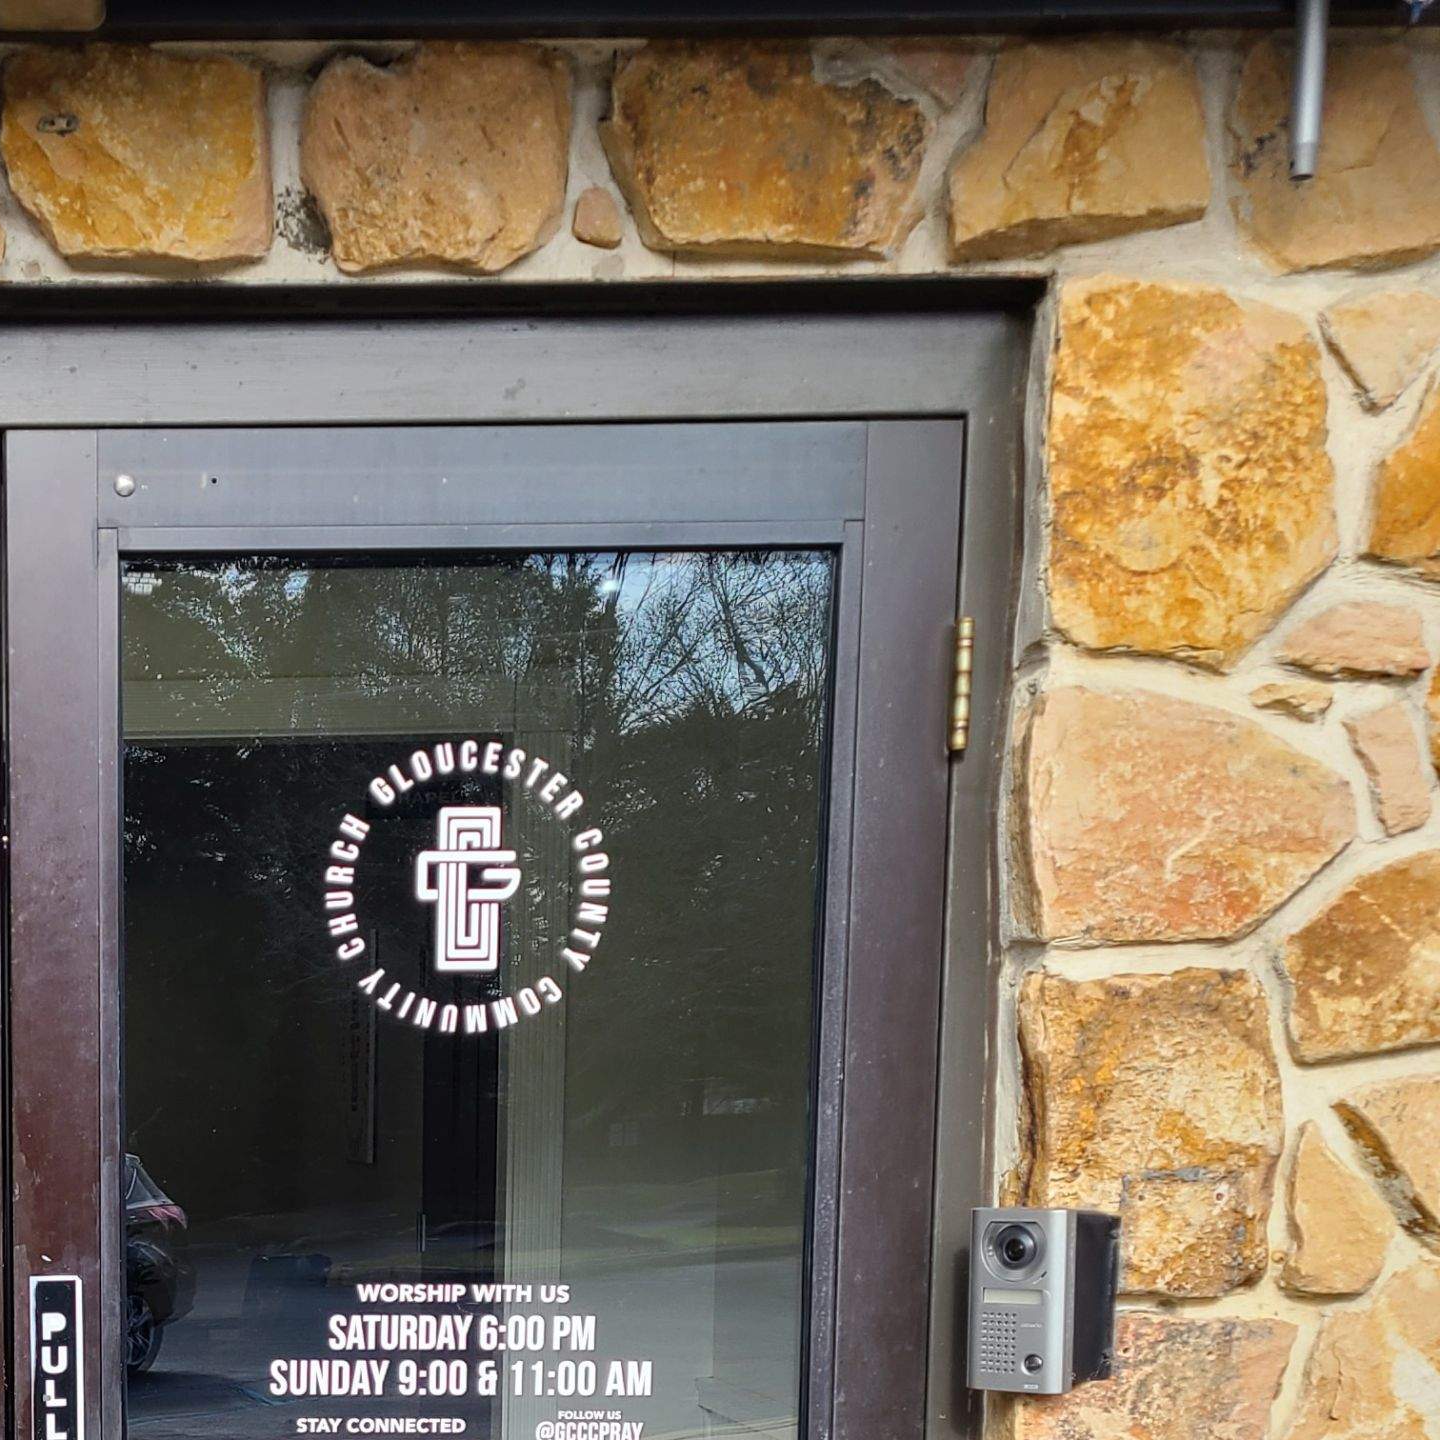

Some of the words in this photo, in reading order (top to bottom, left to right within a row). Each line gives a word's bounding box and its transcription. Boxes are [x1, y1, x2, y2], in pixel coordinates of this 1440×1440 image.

[370, 740, 583, 820] GLOUCESTER
[325, 813, 370, 960] CHURCH
[563, 828, 610, 972] COUNTY
[358, 968, 562, 1034] COMMUNITY
[357, 1283, 466, 1303] WORSHIP
[473, 1284, 532, 1303] WITH
[540, 1284, 570, 1303] US
[328, 1314, 473, 1351] SATURDAY
[479, 1314, 545, 1351] 6:00
[552, 1315, 595, 1351] PM
[41, 1312, 68, 1440] PULL
[269, 1359, 390, 1396] SUNDAY
[398, 1359, 467, 1396] 9:00
[478, 1359, 498, 1396] &
[510, 1360, 596, 1396] 11:00
[605, 1361, 653, 1396] AM
[296, 1418, 342, 1433] STAY
[346, 1418, 466, 1433] CONNECTED
[557, 1410, 604, 1421] FOLLOW
[606, 1410, 622, 1421] US
